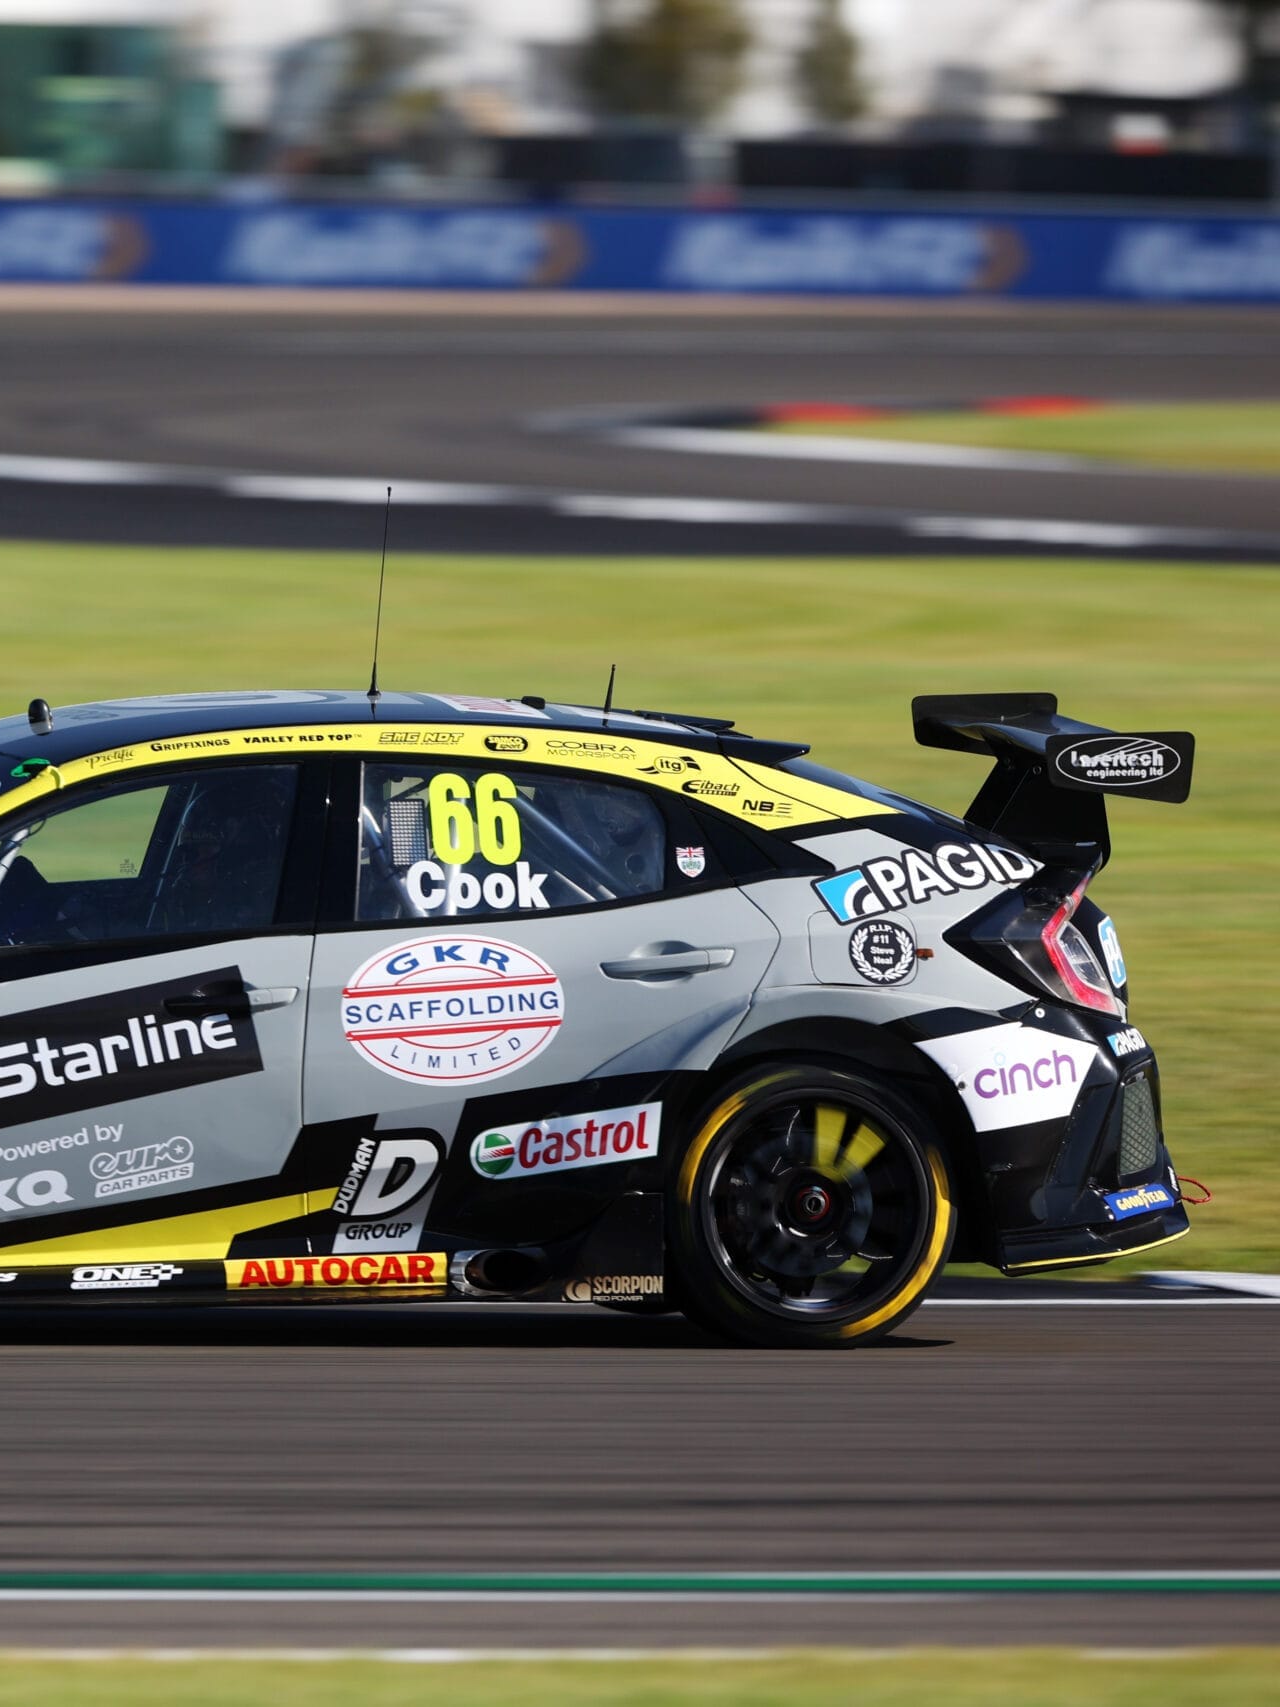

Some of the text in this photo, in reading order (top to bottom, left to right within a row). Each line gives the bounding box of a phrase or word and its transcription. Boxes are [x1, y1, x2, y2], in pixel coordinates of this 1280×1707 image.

[243, 735, 294, 743] VARLEY
[378, 732, 421, 742] SMG
[545, 740, 636, 753] COBRA
[547, 749, 637, 760] MOTORSPORT
[659, 758, 682, 772] itg
[681, 779, 741, 794] Eibach
[1086, 767, 1164, 779] engineering ltd
[428, 772, 521, 865] 66
[406, 860, 551, 910] Cook
[867, 843, 1035, 906] PAGID
[386, 945, 510, 976] GKR
[346, 990, 559, 1024] SCAFFOLDING
[391, 1036, 521, 1069] LIMITED
[974, 1050, 1077, 1099] cinch
[93, 1123, 125, 1144] by
[519, 1111, 648, 1169] Castrol
[89, 1135, 194, 1179] euro
[99, 1166, 191, 1195] CAR PARTS
[333, 1137, 376, 1215] DUDMAN
[351, 1138, 439, 1216] D
[345, 1222, 412, 1240] GROUP
[240, 1255, 435, 1288] AUTOCAR
[593, 1275, 663, 1294] SCORPION
